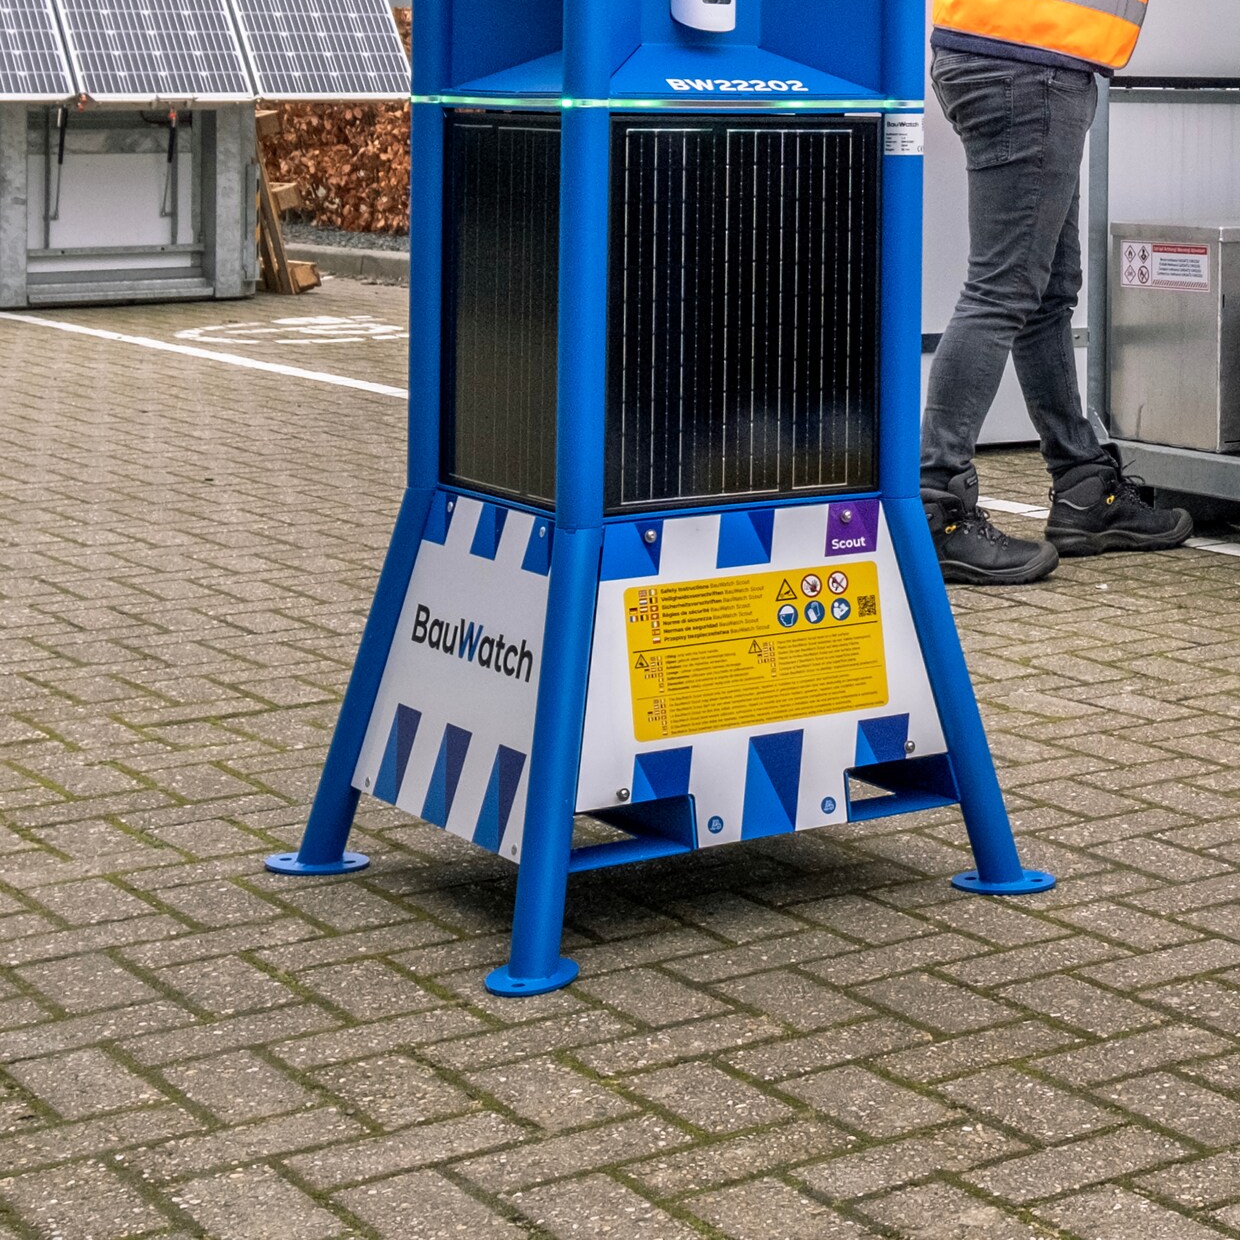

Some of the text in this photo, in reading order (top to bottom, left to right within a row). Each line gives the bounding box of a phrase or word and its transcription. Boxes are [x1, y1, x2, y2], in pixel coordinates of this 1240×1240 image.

[665, 78, 809, 92] BW22202
[831, 536, 866, 550] Scout
[411, 603, 534, 683] BauWatch
